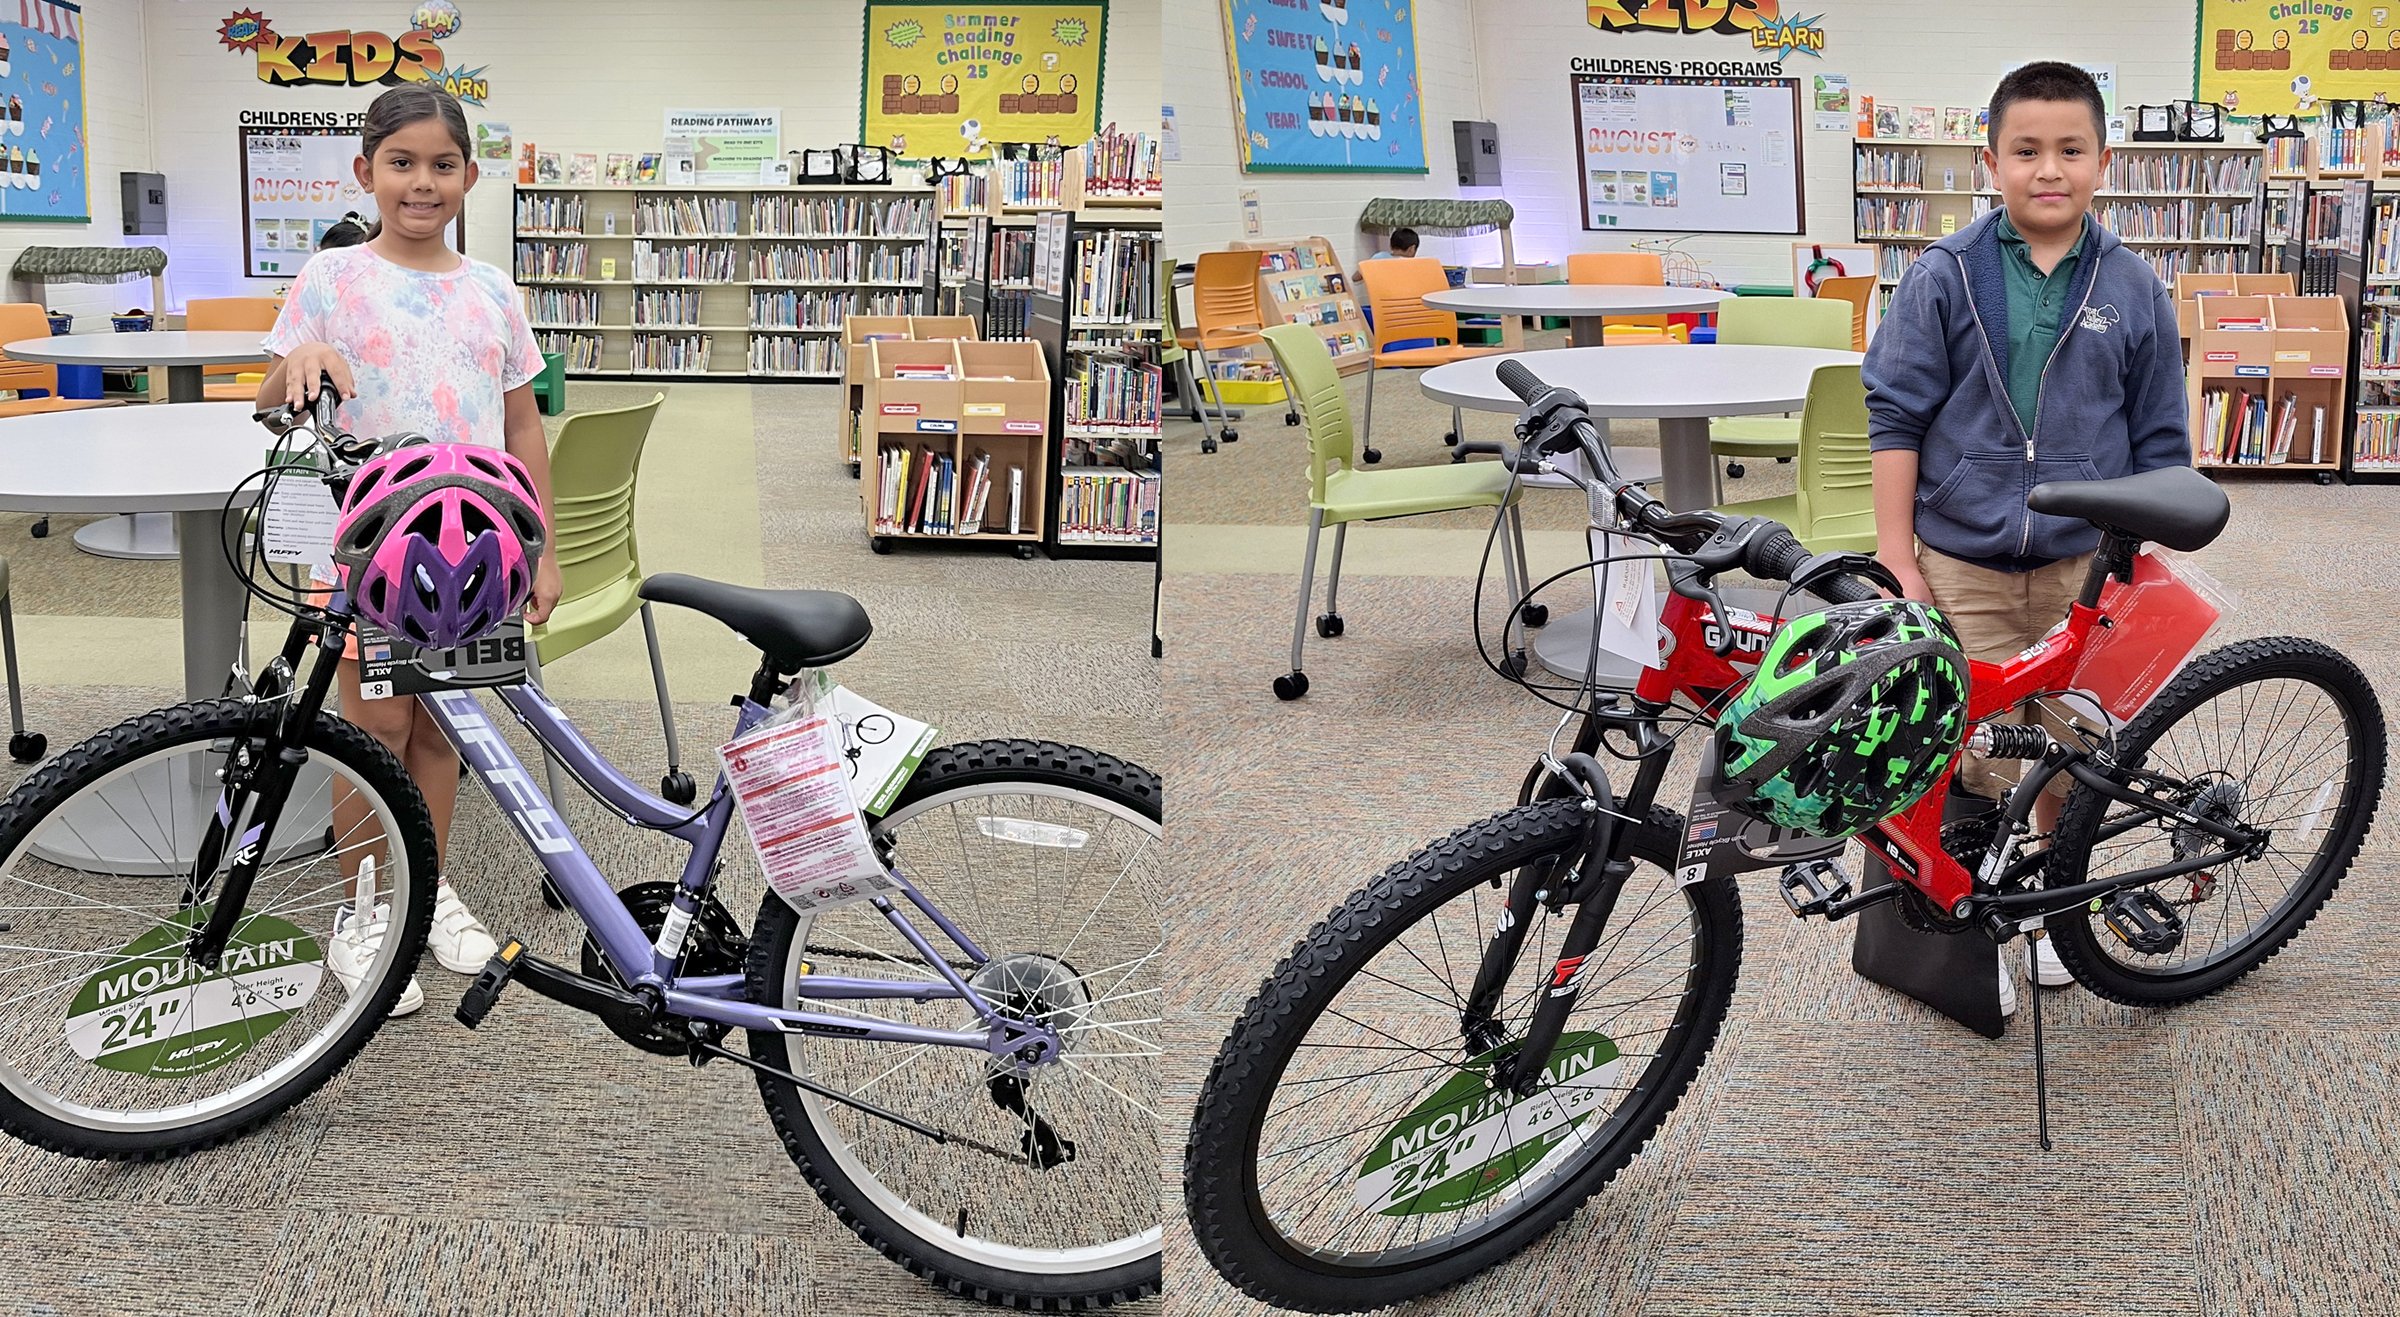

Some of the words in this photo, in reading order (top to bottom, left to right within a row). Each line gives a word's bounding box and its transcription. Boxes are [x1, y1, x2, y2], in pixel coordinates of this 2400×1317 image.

[416, 8, 456, 28] PLAY
[2269, 2, 2353, 21] Challenge
[944, 14, 1021, 29] Summer
[2298, 20, 2319, 34] 25
[943, 28, 1015, 47] Reading
[1267, 29, 1314, 50] SWEET
[1752, 25, 1825, 50] LEARN
[256, 29, 445, 84] KIDS
[937, 46, 1022, 66] Challenge
[966, 64, 988, 79] 25
[1570, 57, 1672, 75] CHILDRENS
[1681, 61, 1783, 76] PROGRAMS
[1260, 69, 1309, 90] SCHOOL
[239, 110, 338, 126] CHILDRENS
[671, 117, 714, 126] READING
[717, 117, 773, 126] PATHWAYS
[1265, 112, 1301, 129] YEAR!
[385, 659, 407, 667] Bicycle
[430, 689, 574, 854] UFFY
[232, 981, 255, 993] Rider
[257, 976, 285, 989] Height
[98, 1006, 127, 1018] Wheel
[129, 1000, 146, 1010] Size
[167, 1038, 228, 1061] HUFFY
[206, 1057, 220, 1065] wear
[1390, 1045, 1596, 1163] MOUNAIN
[1530, 1098, 1552, 1112] Rider
[1390, 1156, 1420, 1171] Wheel
[1422, 1145, 1444, 1162] Size
[1452, 1197, 1464, 1206] safe
[1476, 1186, 1496, 1199] always
